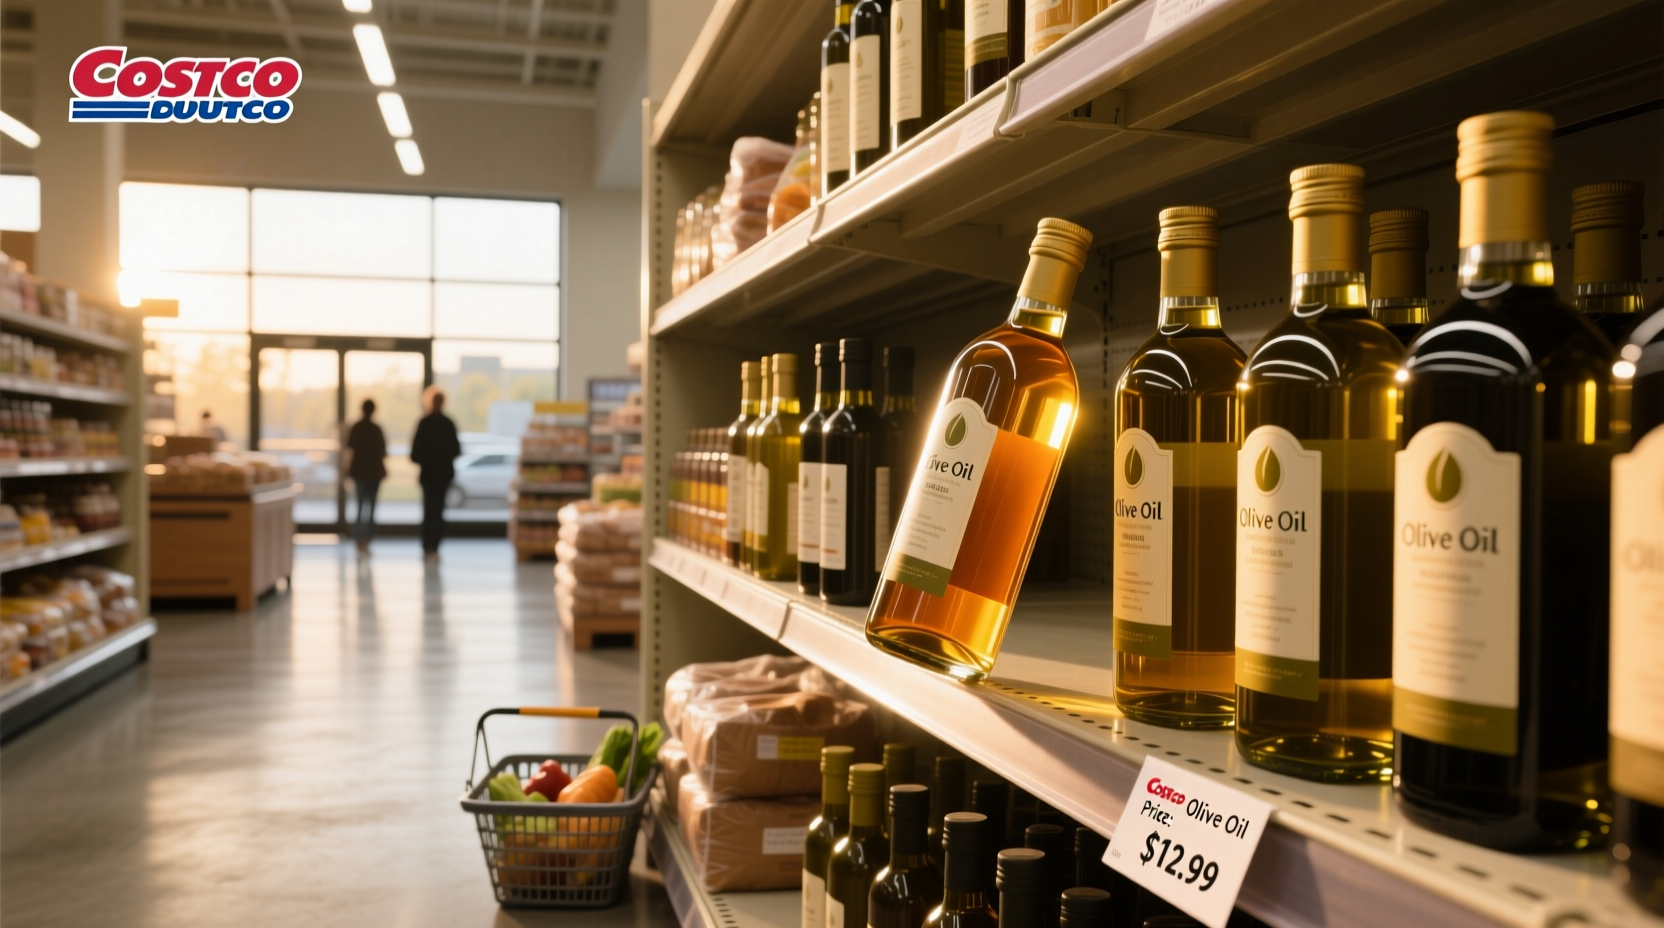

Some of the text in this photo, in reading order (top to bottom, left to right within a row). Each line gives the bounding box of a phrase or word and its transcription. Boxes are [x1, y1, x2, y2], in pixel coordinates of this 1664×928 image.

[951, 461, 974, 481] Oil
[1140, 501, 1163, 520] Oil
[1239, 507, 1307, 532] Olive Oil
[1402, 522, 1500, 554] Olive Oil
[1140, 800, 1174, 827] Price:
[1186, 798, 1223, 828] Olive
[1224, 815, 1250, 839] Oil
[1140, 830, 1219, 892] $12.99
